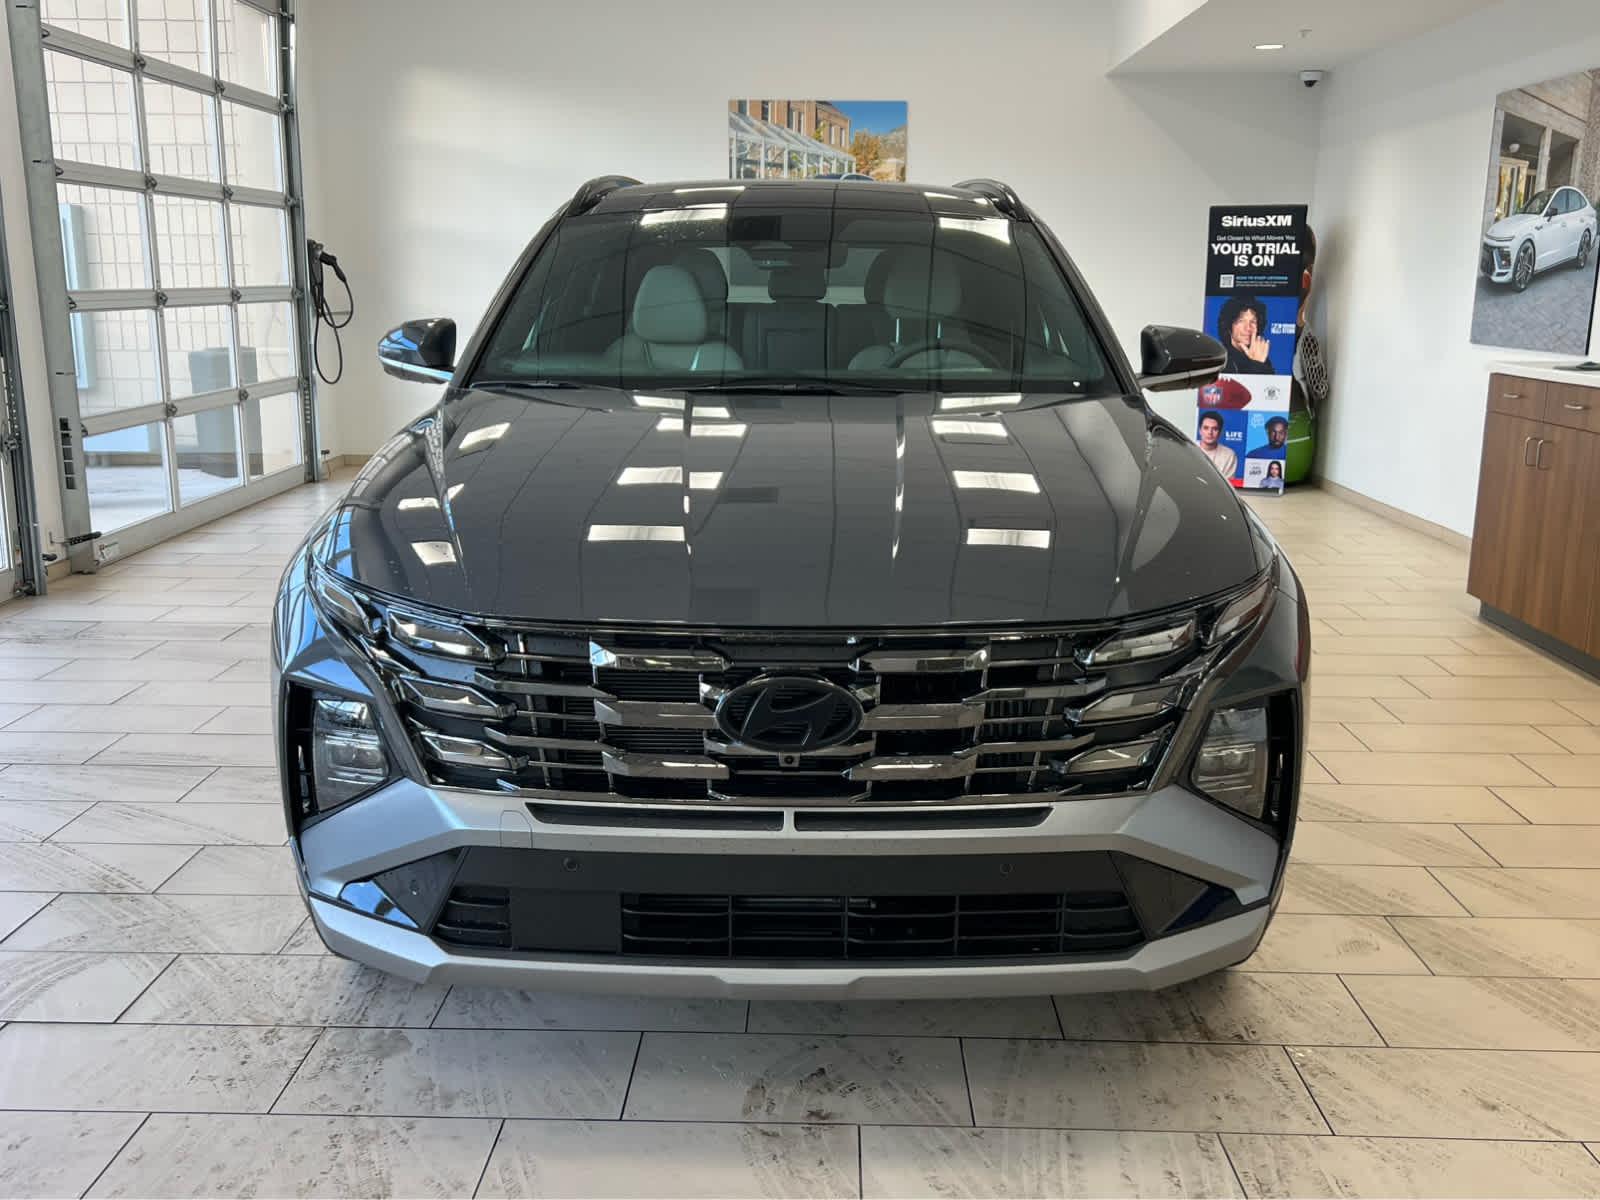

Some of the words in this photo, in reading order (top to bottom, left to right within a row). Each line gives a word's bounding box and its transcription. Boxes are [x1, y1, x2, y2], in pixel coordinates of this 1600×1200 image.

[1221, 214, 1293, 227] SiriusXM
[1211, 242, 1253, 255] YOUR
[1255, 242, 1301, 255] TRIAL
[1234, 255, 1249, 267] IS
[1251, 255, 1275, 267] ON
